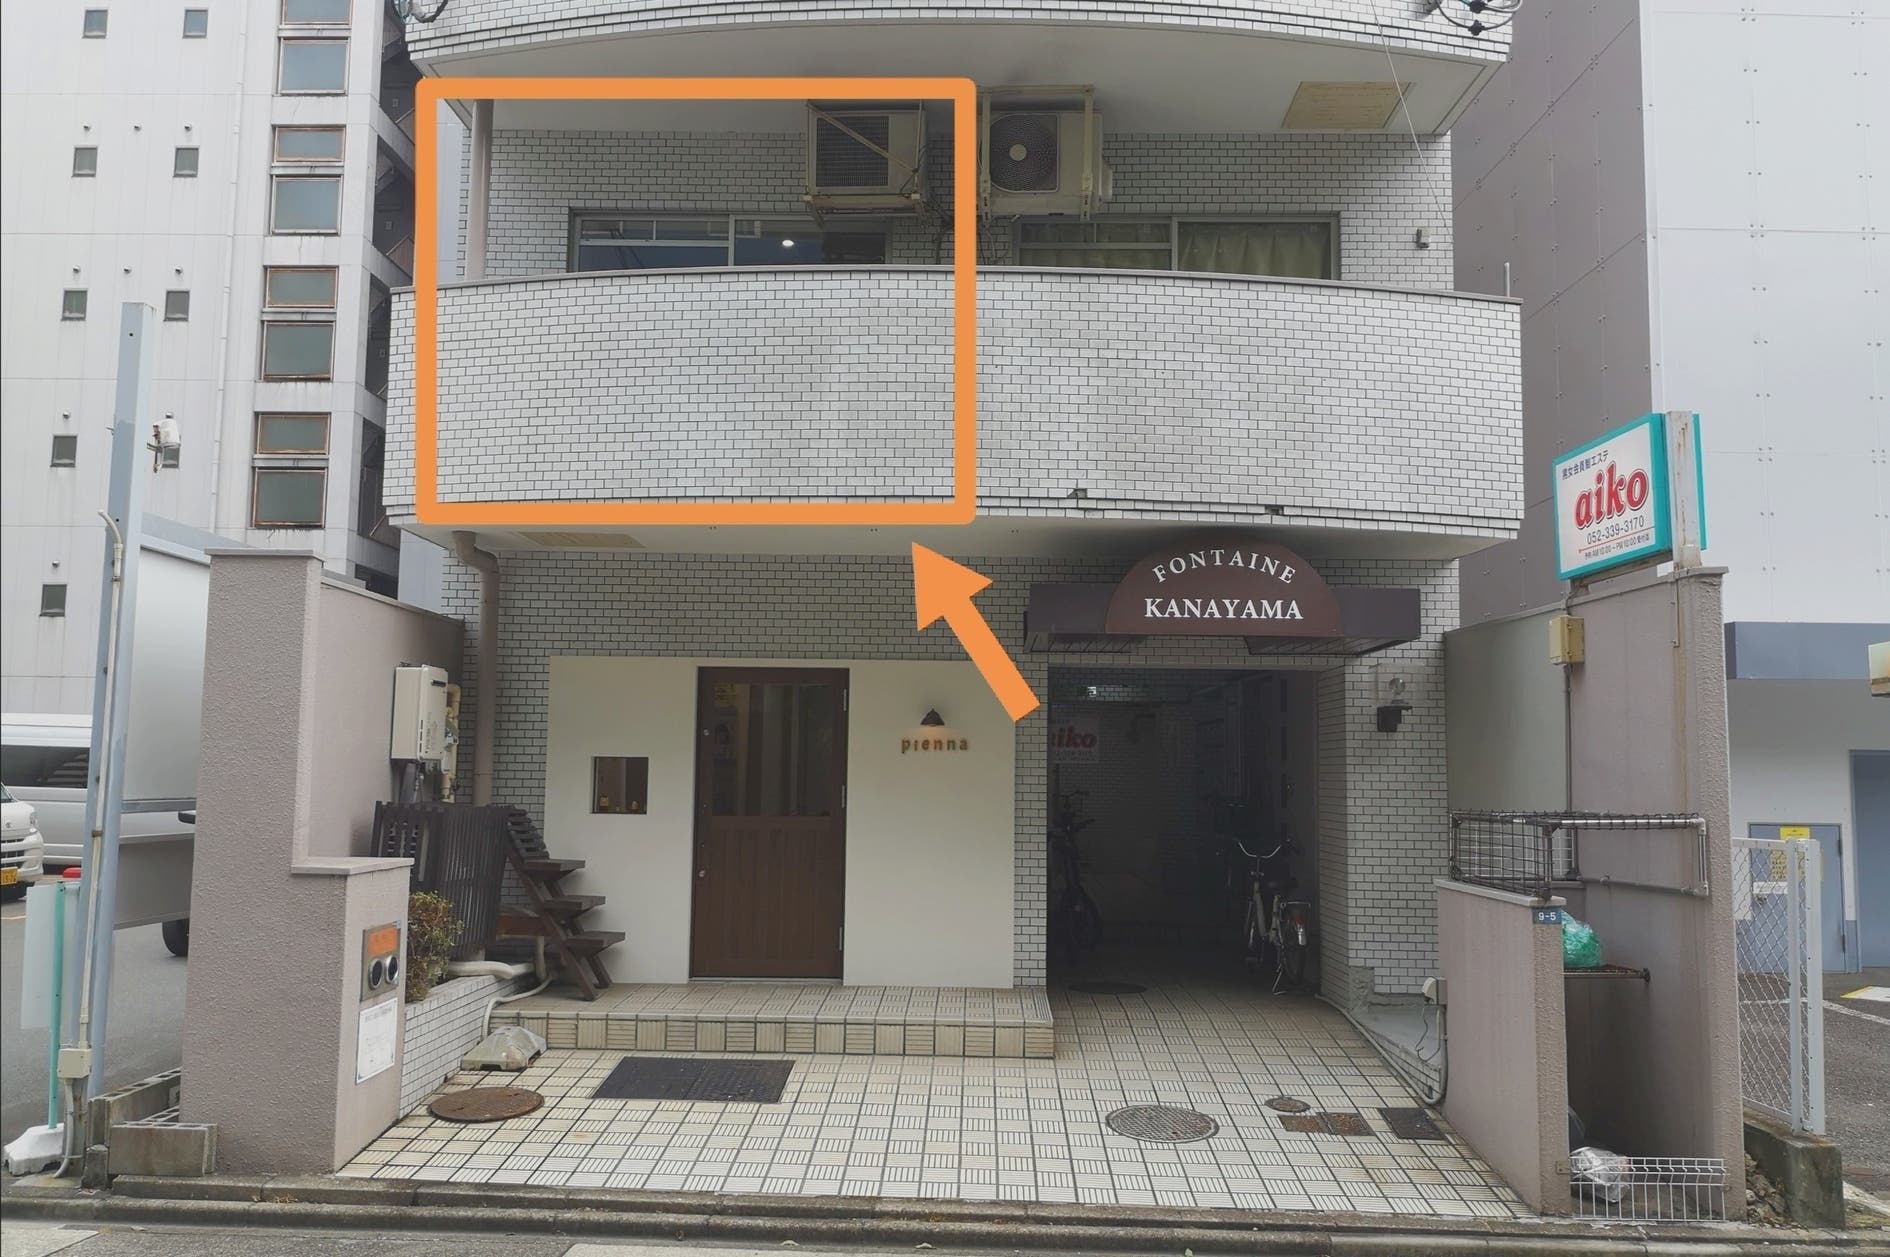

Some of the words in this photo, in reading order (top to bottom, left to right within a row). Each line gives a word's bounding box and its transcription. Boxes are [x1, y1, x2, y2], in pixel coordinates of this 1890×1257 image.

[1575, 460, 1649, 530] aiko
[1587, 515, 1644, 544] 052-339-3170
[1152, 549, 1296, 583] FONTAINE
[1144, 598, 1303, 619] KANAYAMA
[901, 738, 968, 754] pienna
[1538, 912, 1556, 921] 9-5
